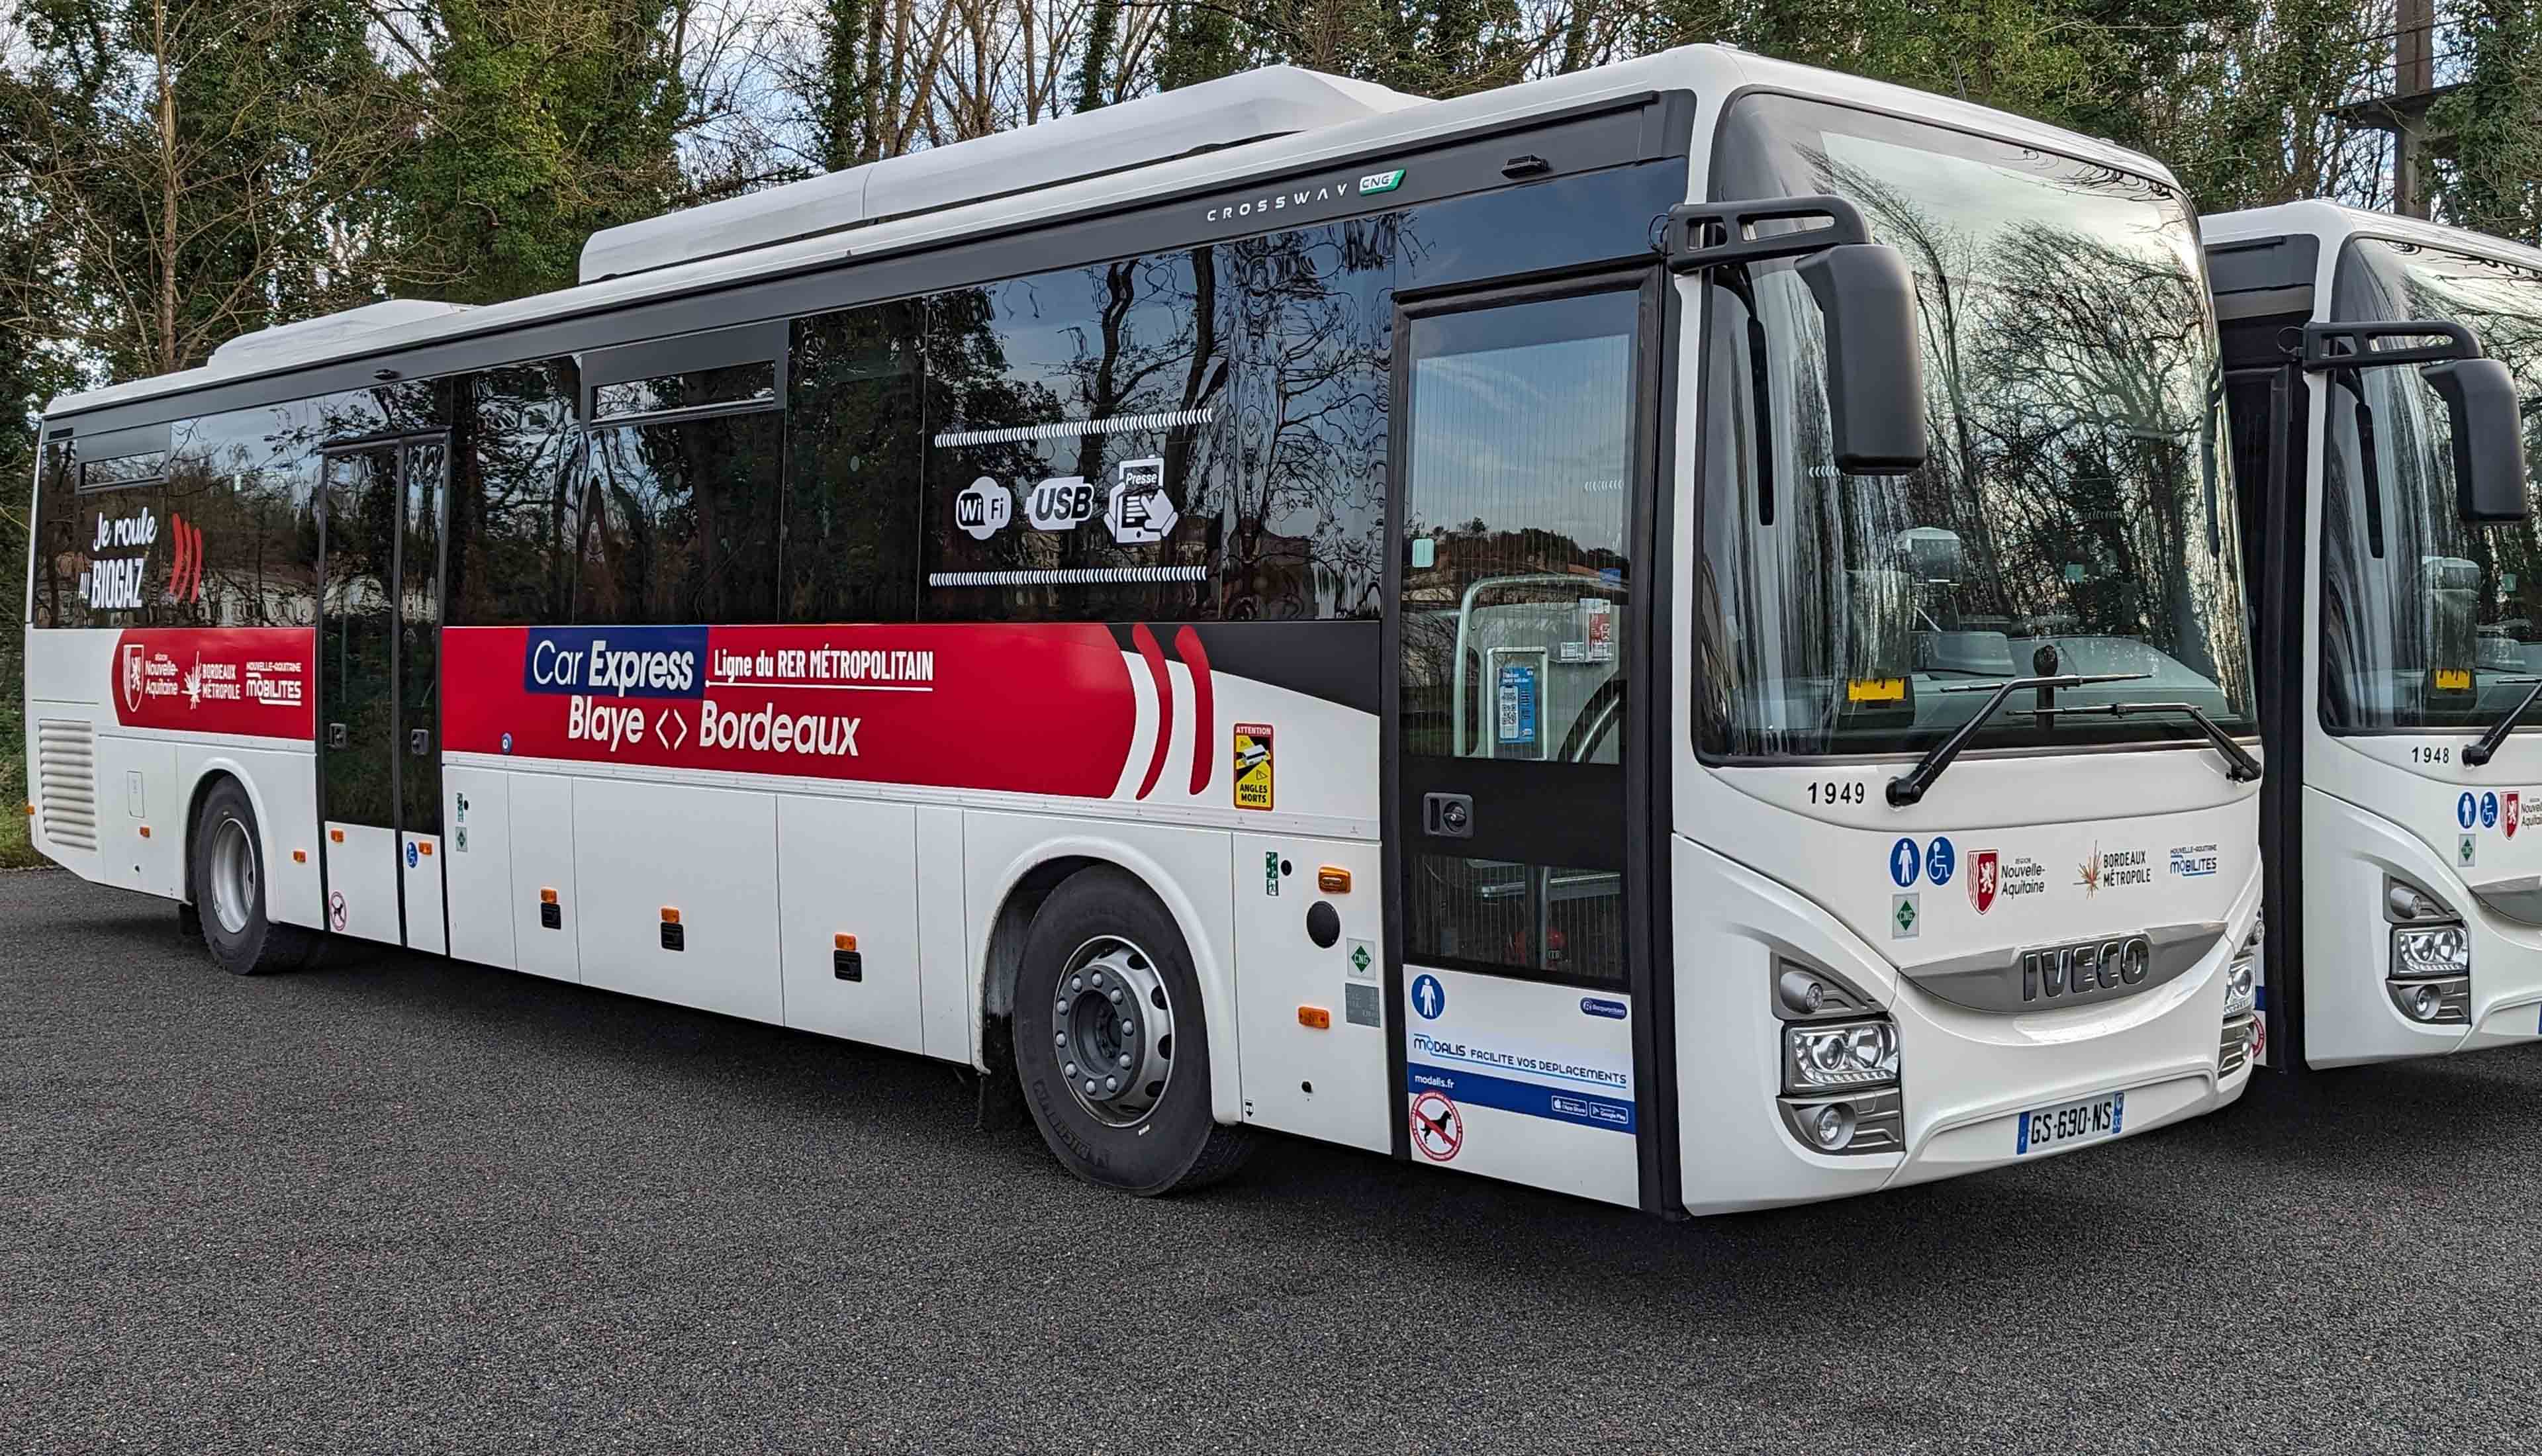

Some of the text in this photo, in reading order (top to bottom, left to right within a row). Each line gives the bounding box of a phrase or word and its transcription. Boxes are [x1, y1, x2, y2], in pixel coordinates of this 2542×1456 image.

[1361, 175, 1389, 188] CNG
[1126, 472, 1157, 485] Presse
[1035, 486, 1092, 521] USB
[93, 506, 158, 551] Je roule
[78, 558, 144, 608] AU BIOGAZ
[202, 664, 236, 680] BORDEAUX
[533, 640, 694, 698] Car Express
[714, 643, 933, 683] Ligne du RER MÉTROPOLITAIN
[145, 678, 178, 699] Aquitaine
[202, 680, 240, 700] MÉTROPOLE
[568, 695, 861, 756] Blaye Bordeaux
[2412, 747, 2449, 764] 1948
[1240, 784, 1267, 794] ANGLES
[1241, 794, 1266, 803] MORTS
[1808, 782, 1864, 804] 1949
[2103, 850, 2146, 868] BORDEAUX
[2001, 864, 2046, 878] Nouvelle-
[2103, 868, 2151, 887] MÉTROPOLE
[2001, 880, 2045, 899] Aquitaine
[1899, 910, 1914, 921] CNG
[1354, 953, 1368, 964] CNG
[2024, 938, 2150, 1001] IVECO
[1470, 1049, 1514, 1065] FACILITE
[1517, 1057, 1536, 1069] VOS
[1539, 1061, 1626, 1084] DEPLACEMENTS
[1415, 1075, 1454, 1089] modalis.fr
[2031, 1101, 2112, 1144] GS-690-NS
